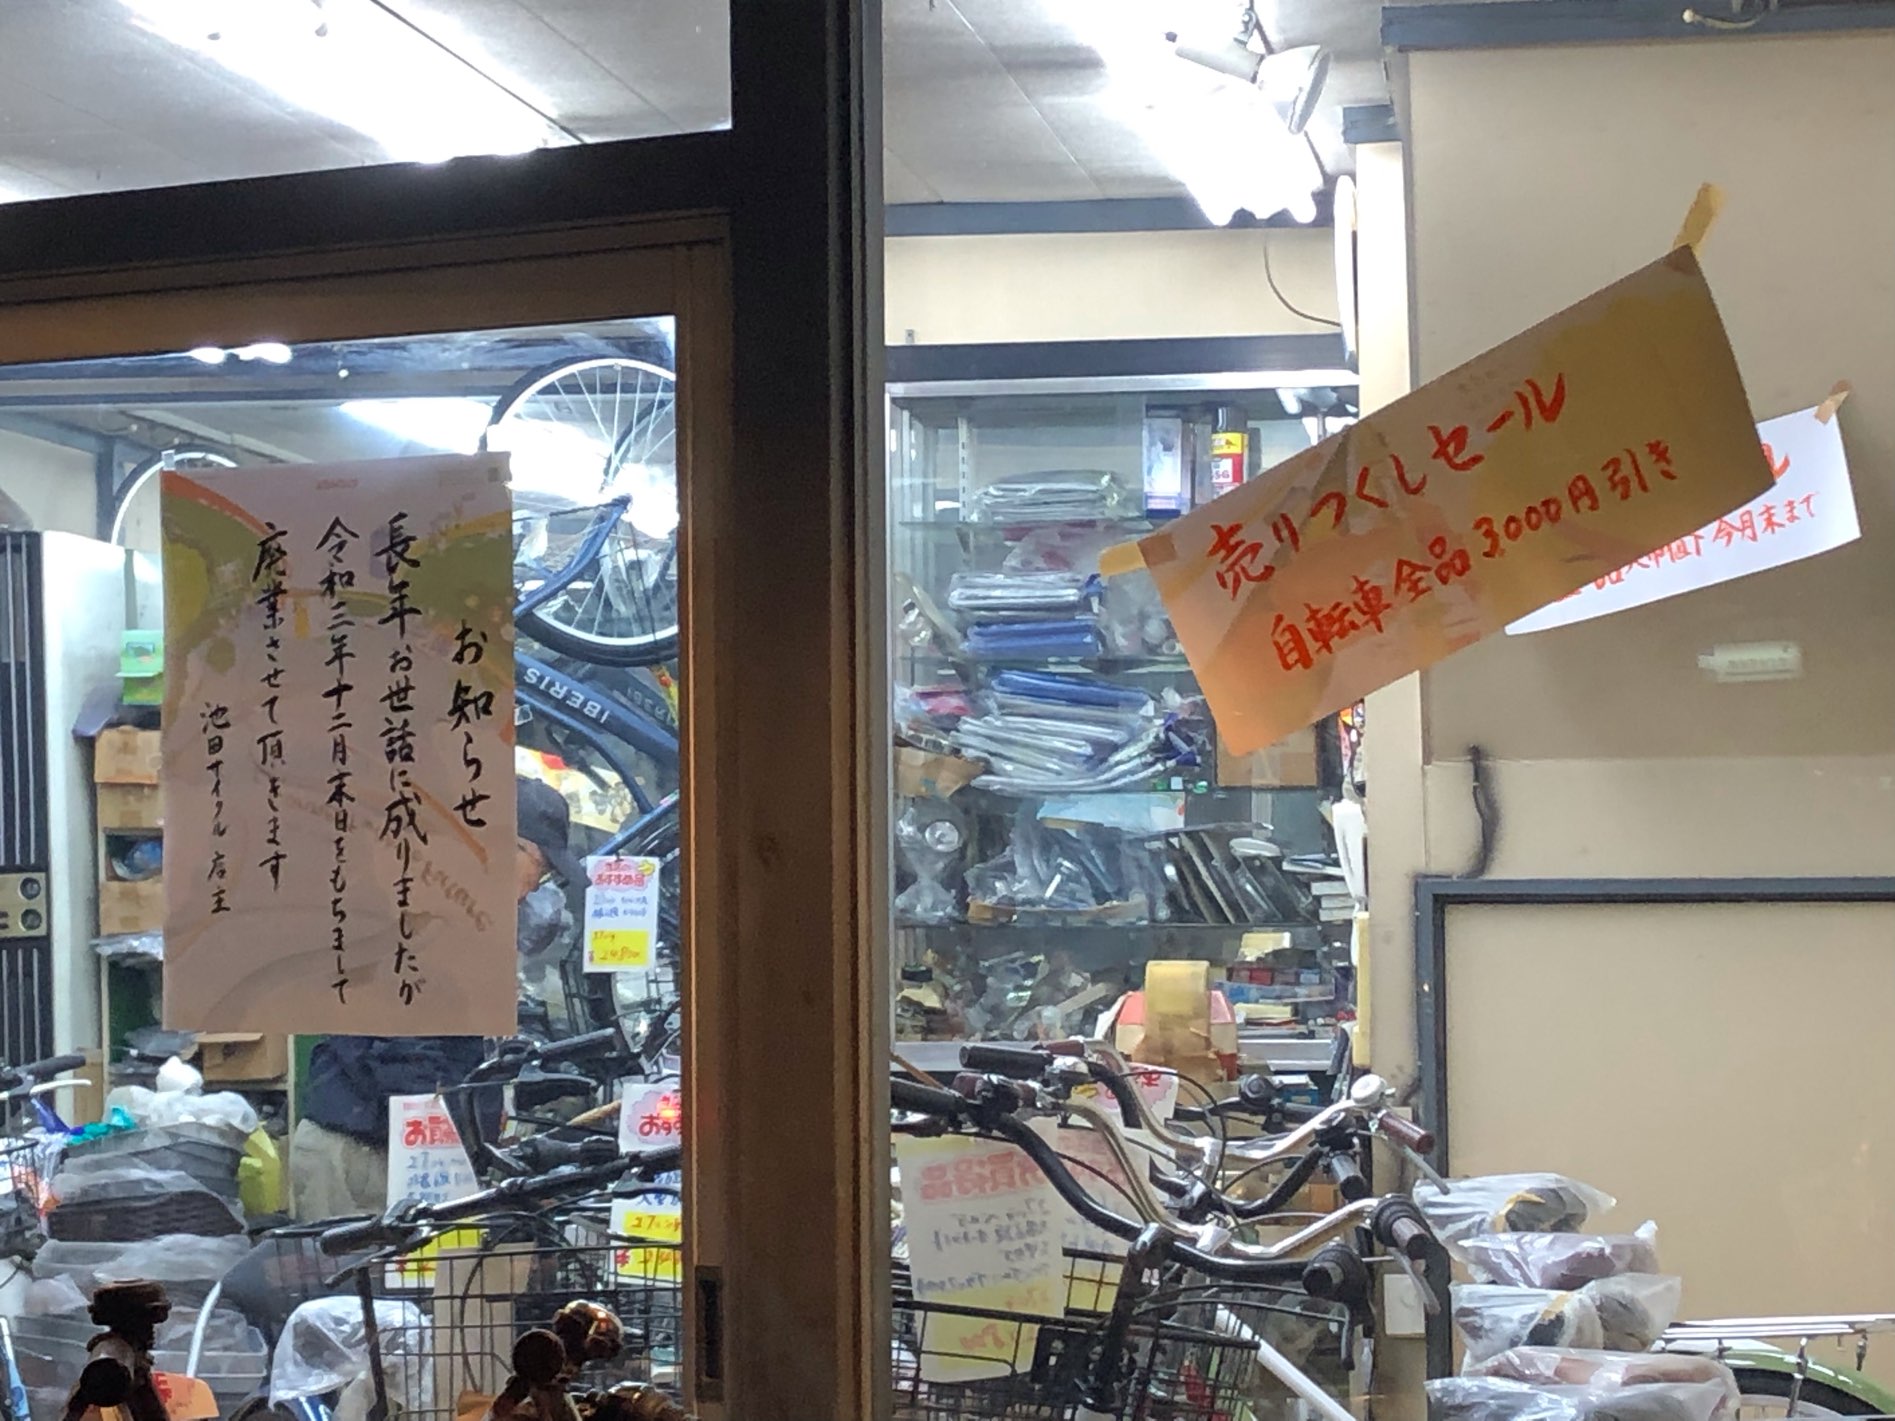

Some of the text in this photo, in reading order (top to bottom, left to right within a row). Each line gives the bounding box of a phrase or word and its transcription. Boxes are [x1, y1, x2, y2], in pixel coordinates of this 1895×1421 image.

[1205, 372, 1567, 600] 売りつくしセール
[251, 520, 288, 892] 廃業させて頂きます
[314, 516, 360, 1005] 令和三年十二月末日をもちまして
[371, 512, 427, 1006] 長年お世話に成りましたが
[447, 619, 496, 830] お知らせ
[523, 667, 611, 725] IBERIS
